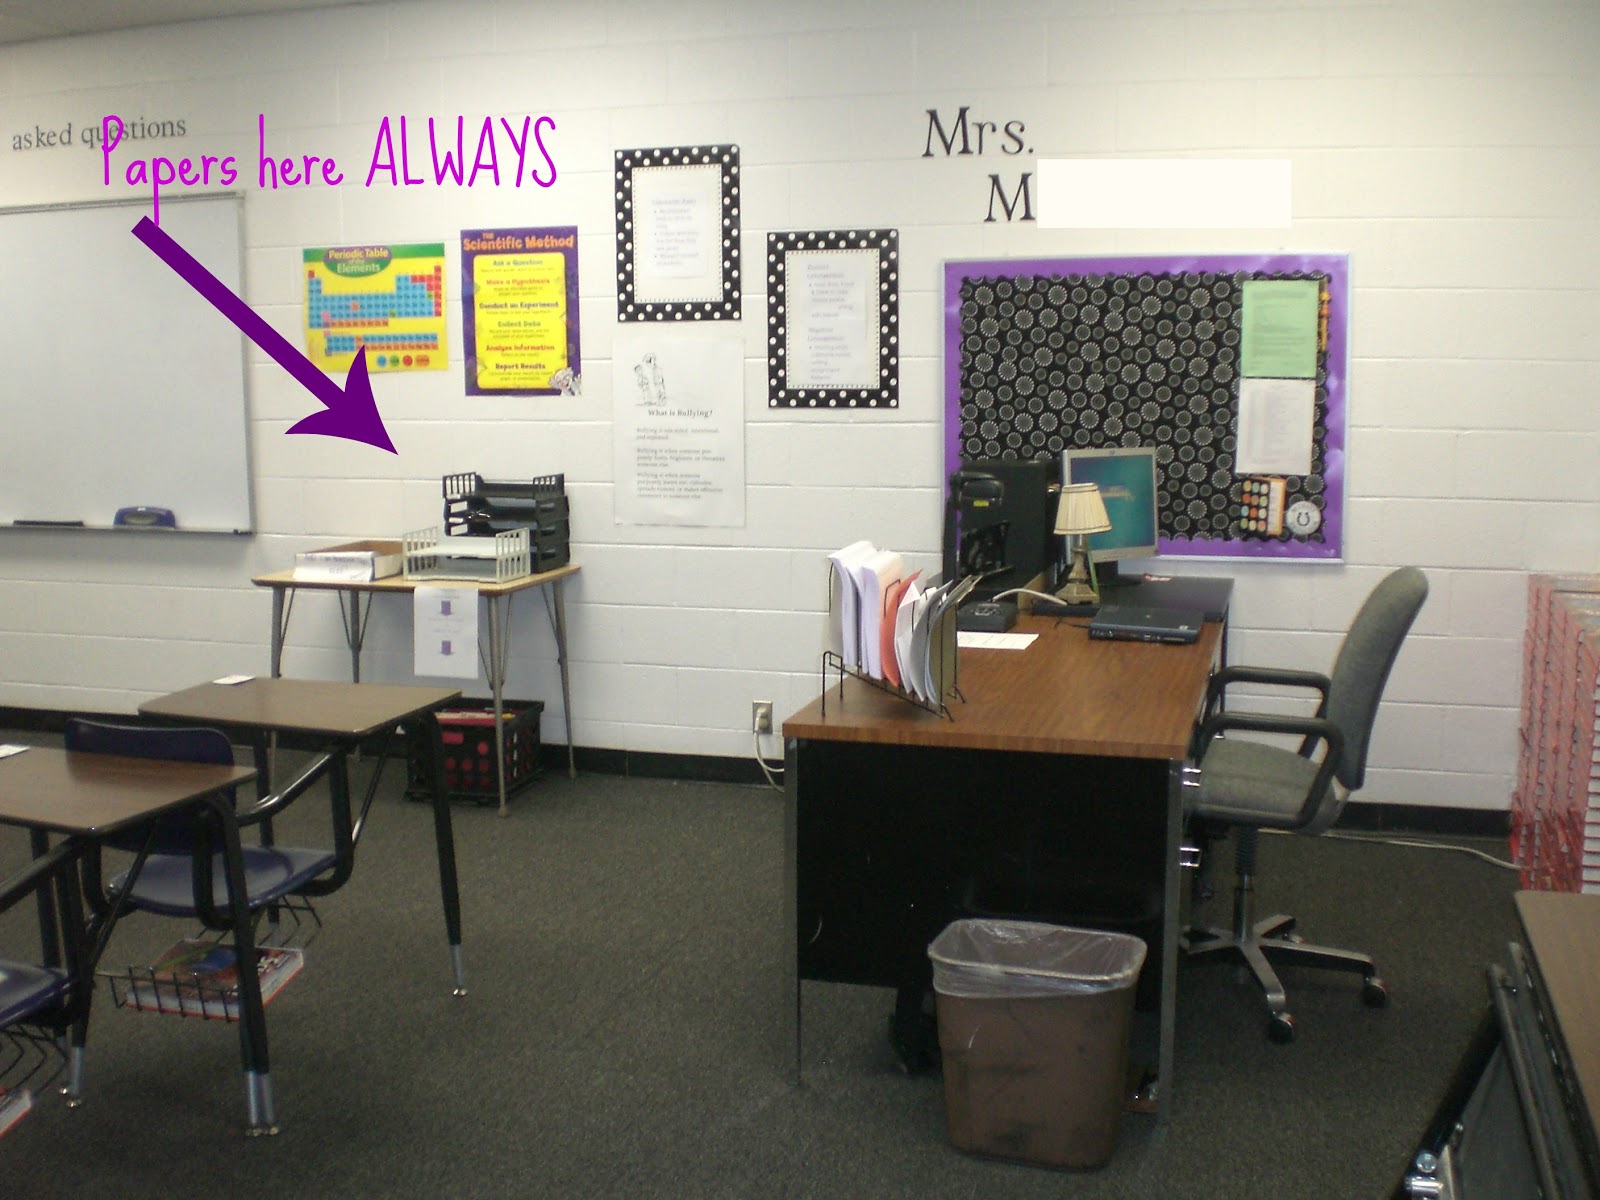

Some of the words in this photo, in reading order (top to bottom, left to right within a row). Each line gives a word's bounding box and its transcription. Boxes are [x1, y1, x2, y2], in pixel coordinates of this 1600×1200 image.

[12, 123, 72, 151] asked
[81, 117, 187, 150] questions
[922, 106, 1034, 157] Mrs.
[463, 236, 523, 251] Scientific
[525, 235, 575, 249] Method
[328, 249, 364, 259] Periodic
[365, 247, 389, 257] Table
[337, 263, 380, 273] Elements
[520, 301, 559, 310] Experiment
[677, 409, 713, 418] Bullying?
